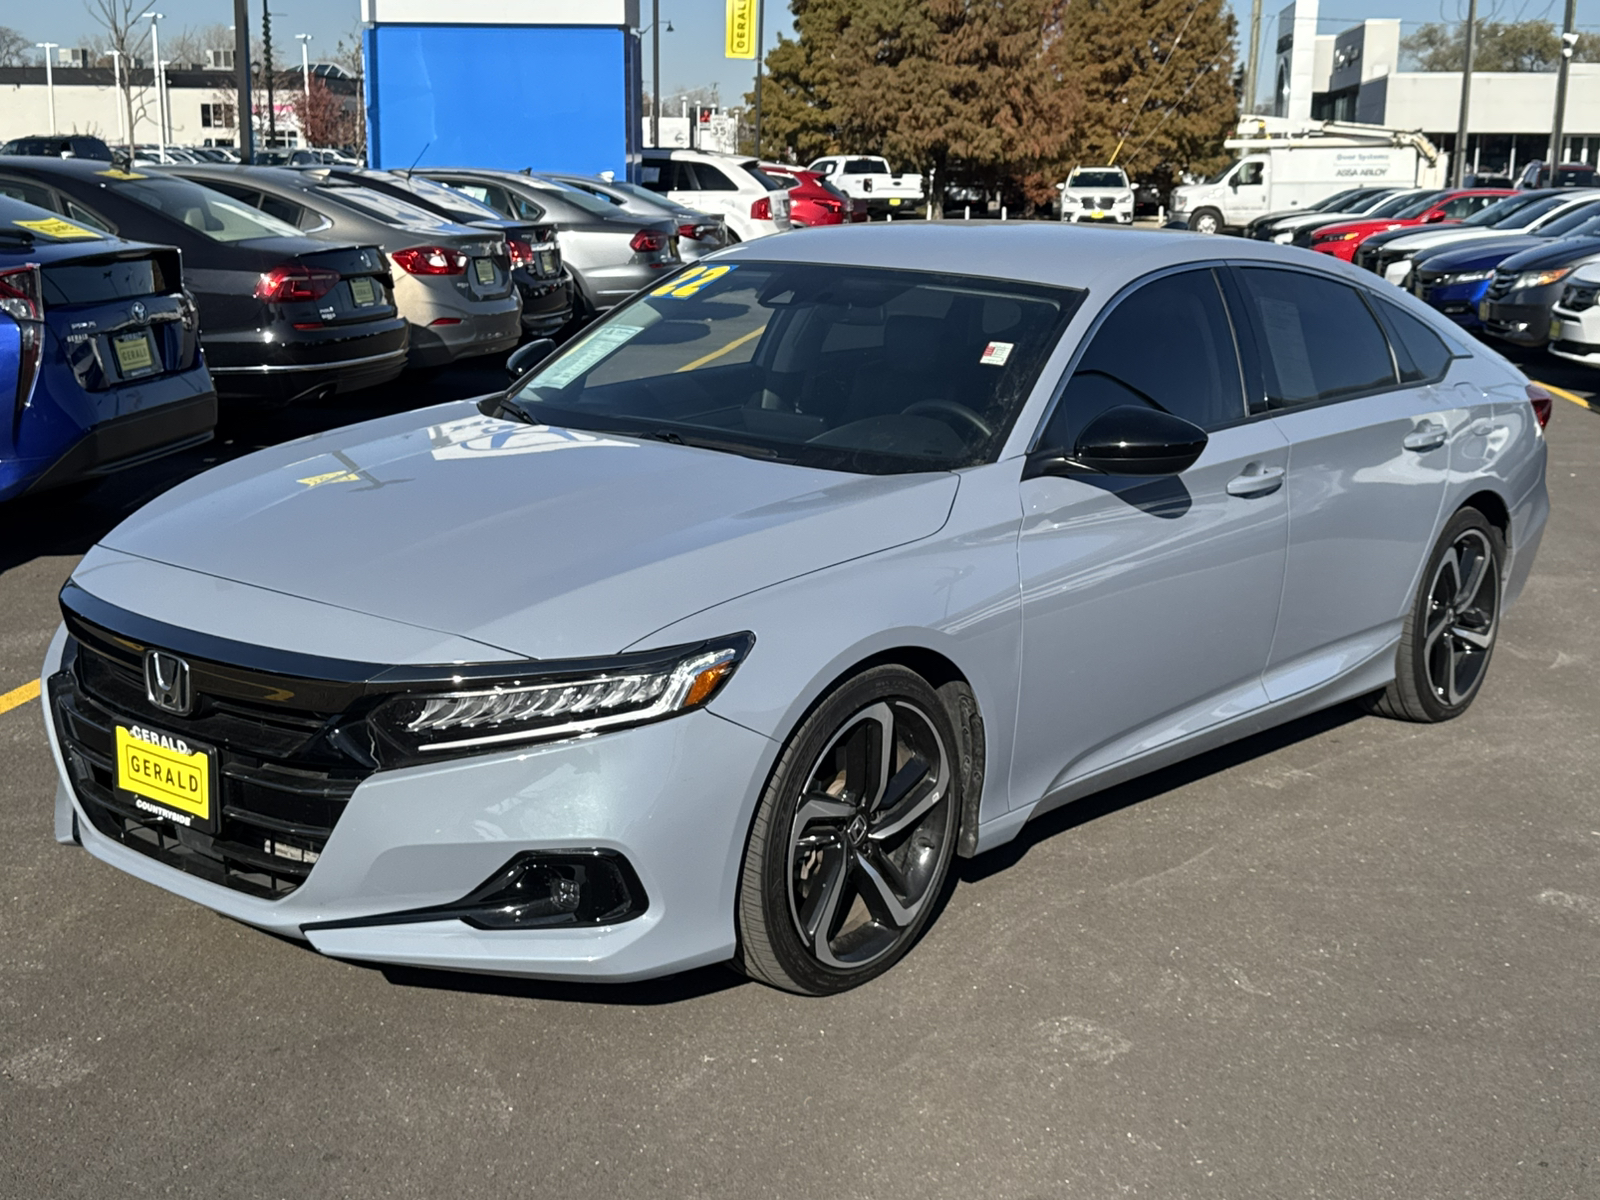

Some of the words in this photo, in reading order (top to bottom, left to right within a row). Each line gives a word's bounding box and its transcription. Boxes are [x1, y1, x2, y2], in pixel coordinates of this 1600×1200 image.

[736, 0, 747, 49] GERAL
[712, 126, 727, 136] 35
[650, 264, 731, 298] 22
[131, 725, 188, 755] GERALD
[130, 755, 199, 793] GERALD
